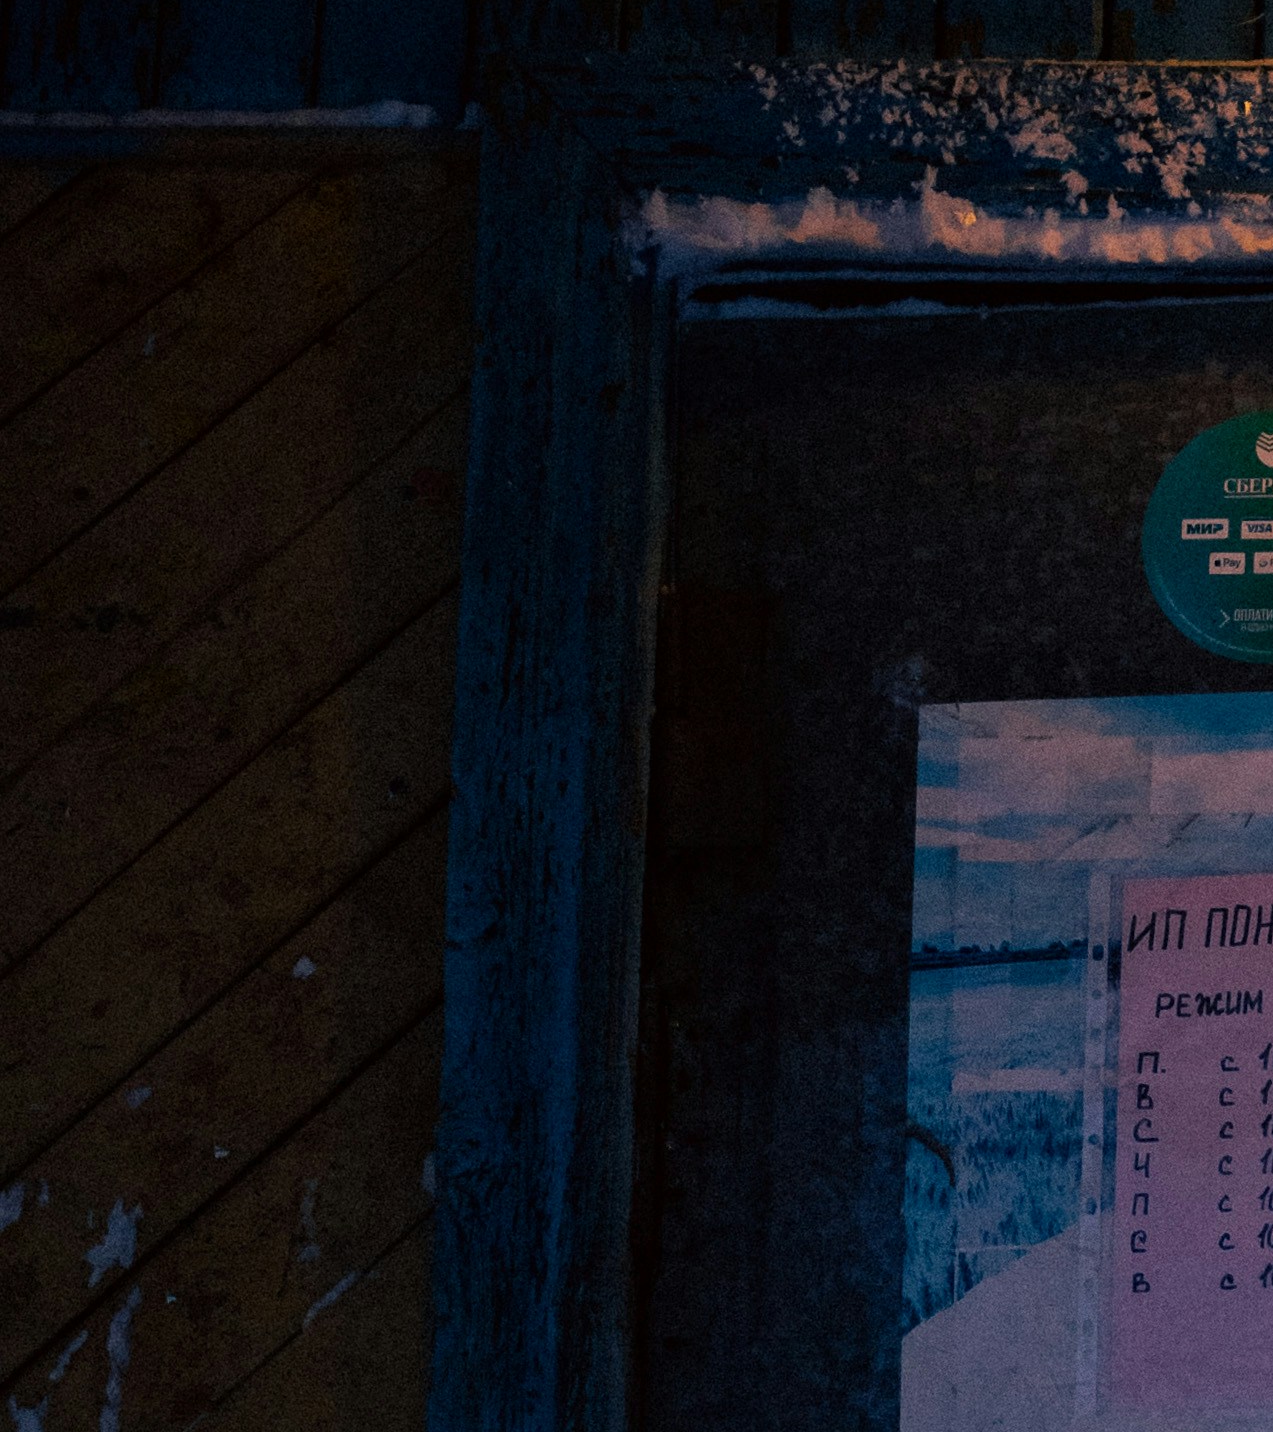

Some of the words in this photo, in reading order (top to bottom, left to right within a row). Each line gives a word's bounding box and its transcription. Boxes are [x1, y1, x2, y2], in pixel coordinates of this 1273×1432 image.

[1186, 523, 1225, 535] МИР
[1246, 523, 1273, 534] VISA
[1222, 557, 1241, 569] Pay
[1126, 909, 1188, 953] ИП
[1154, 988, 1265, 1019] РЕЖИМ
[1136, 1082, 1155, 1110] В
[1132, 1117, 1160, 1144] С
[1133, 1151, 1151, 1179] Ч
[1131, 1192, 1150, 1216] П
[1129, 1228, 1148, 1254] С
[1131, 1271, 1151, 1294] В
